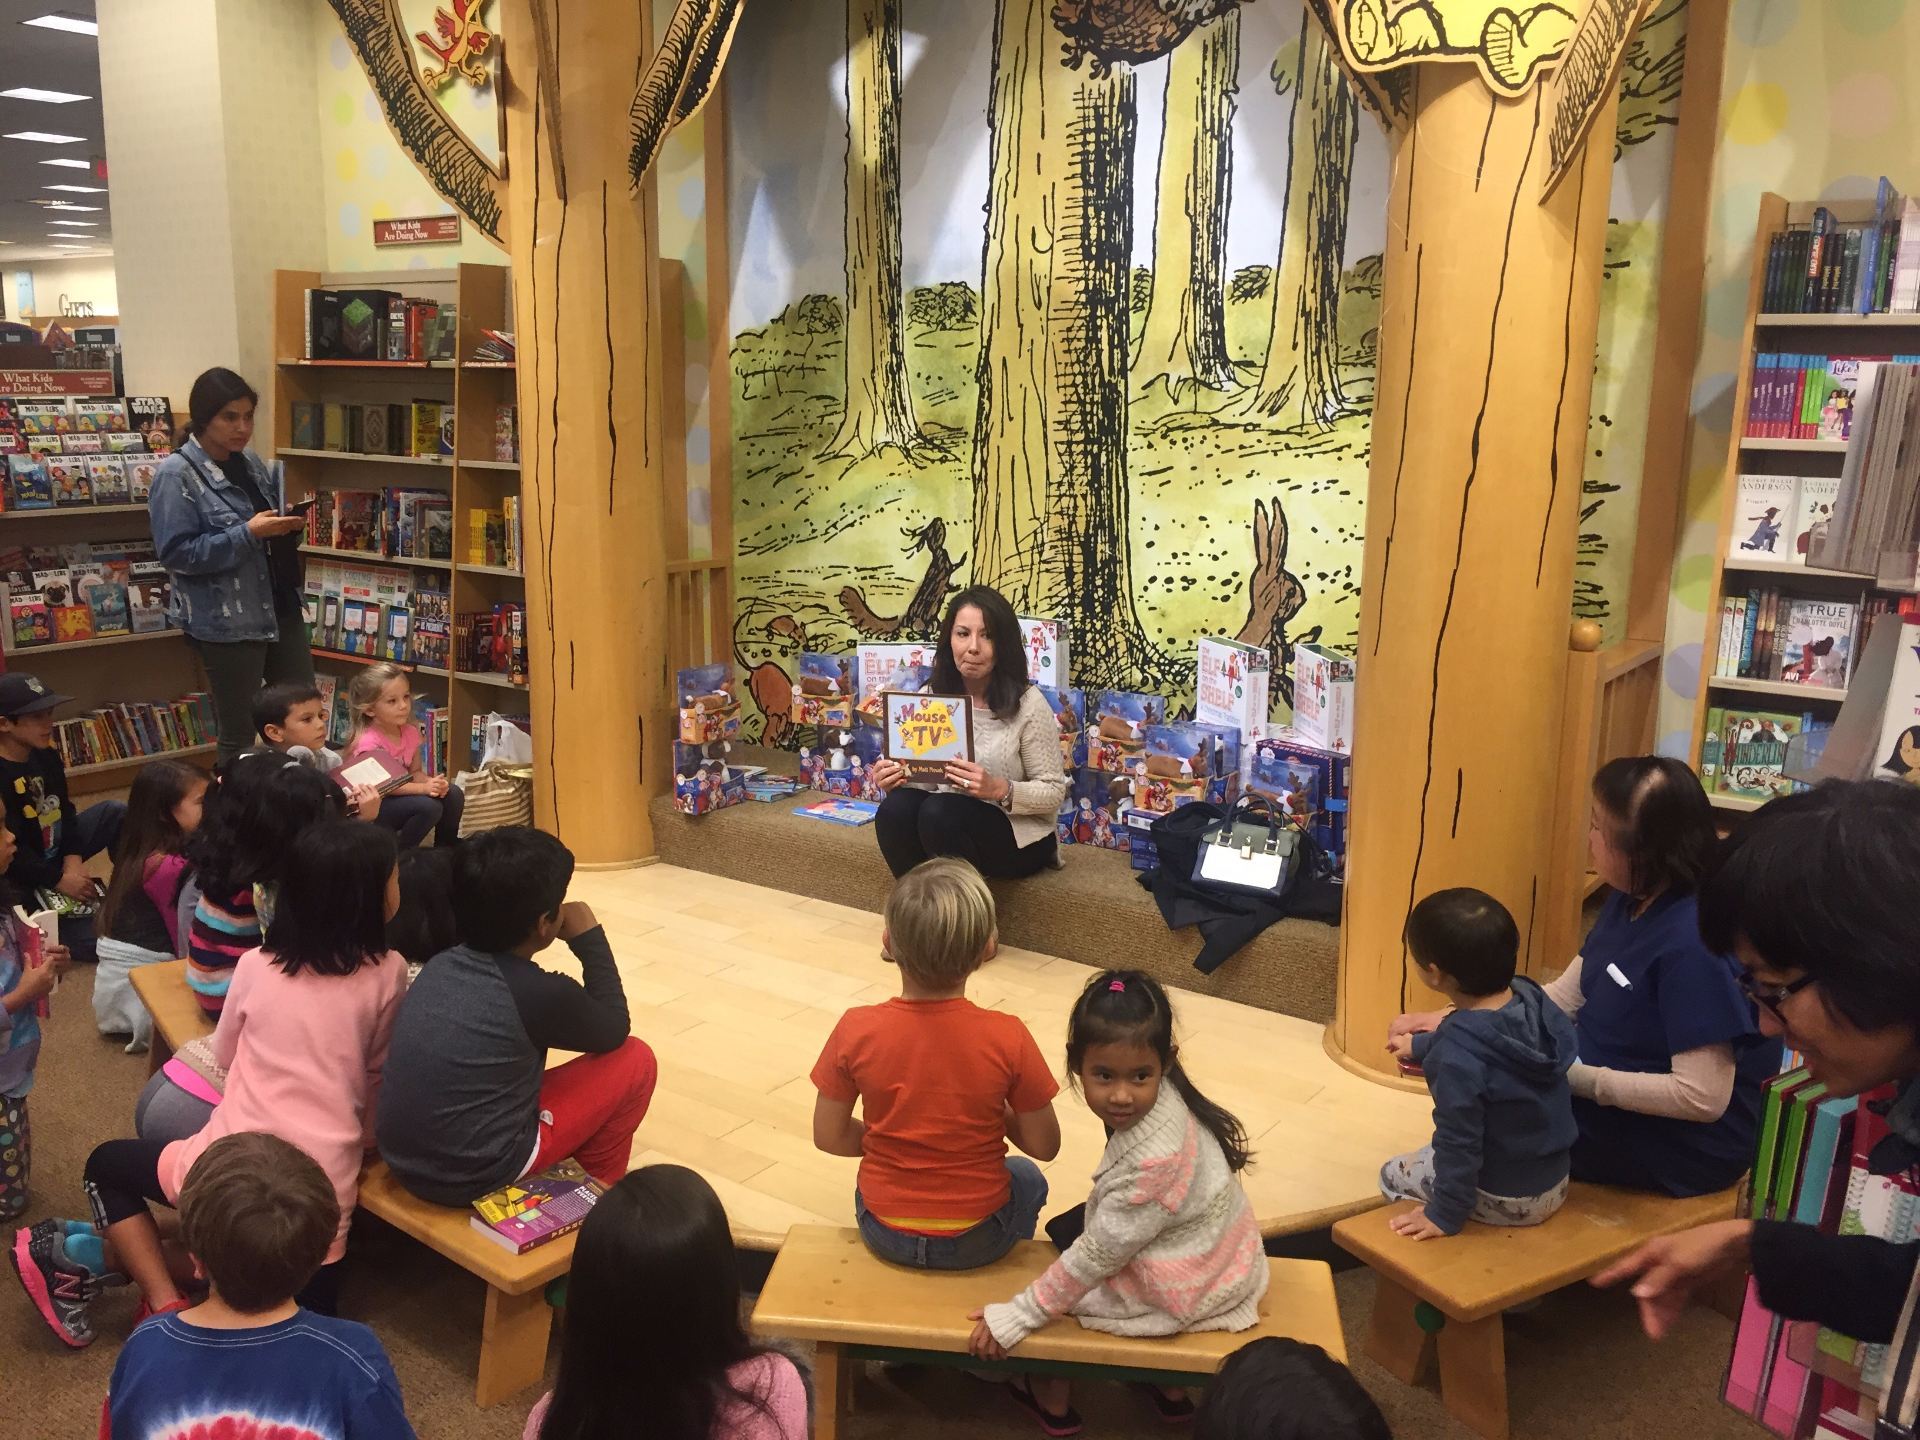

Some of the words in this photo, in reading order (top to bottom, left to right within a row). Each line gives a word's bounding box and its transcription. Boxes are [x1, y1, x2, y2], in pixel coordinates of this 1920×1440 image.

[391, 222, 406, 231] What
[408, 221, 421, 229] Kids
[384, 231, 395, 241] Are
[396, 231, 413, 240] Doing
[415, 229, 428, 239] Now
[3, 373, 30, 383] What
[32, 373, 53, 382] Kids
[13, 382, 42, 394] Doing
[44, 382, 65, 392] Now
[131, 398, 165, 406] STAR
[131, 405, 166, 414] WARS
[1740, 482, 1793, 491] ANDERSON
[1808, 604, 1847, 618] TRUE
[865, 659, 897, 675] ELF
[1201, 655, 1220, 677] ELF
[1784, 671, 1799, 681] AVI
[1200, 684, 1235, 712] SHELF
[901, 703, 947, 724] Mouse
[913, 725, 943, 746] TV
